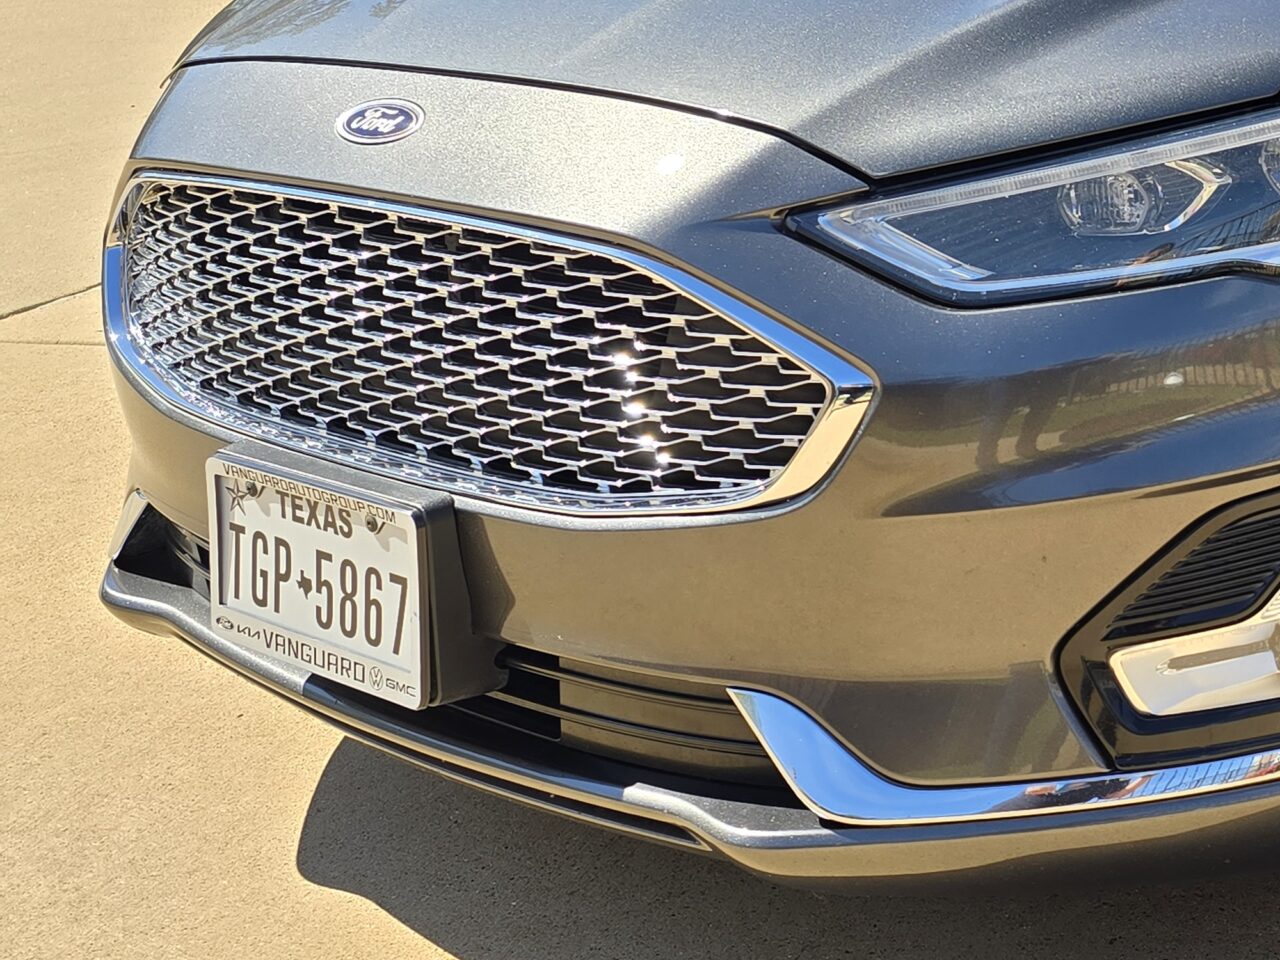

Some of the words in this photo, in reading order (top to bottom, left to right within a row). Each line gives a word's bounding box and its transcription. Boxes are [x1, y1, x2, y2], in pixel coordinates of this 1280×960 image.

[349, 106, 406, 133] Ford
[221, 462, 396, 524] VANGUARDAUTOGROUP.COM
[275, 490, 353, 539] TEXAS
[229, 522, 292, 614] TGP
[315, 548, 408, 656] 5867
[237, 624, 260, 640] KIA
[263, 628, 366, 684] VANGUARD
[385, 677, 417, 698] GMC
